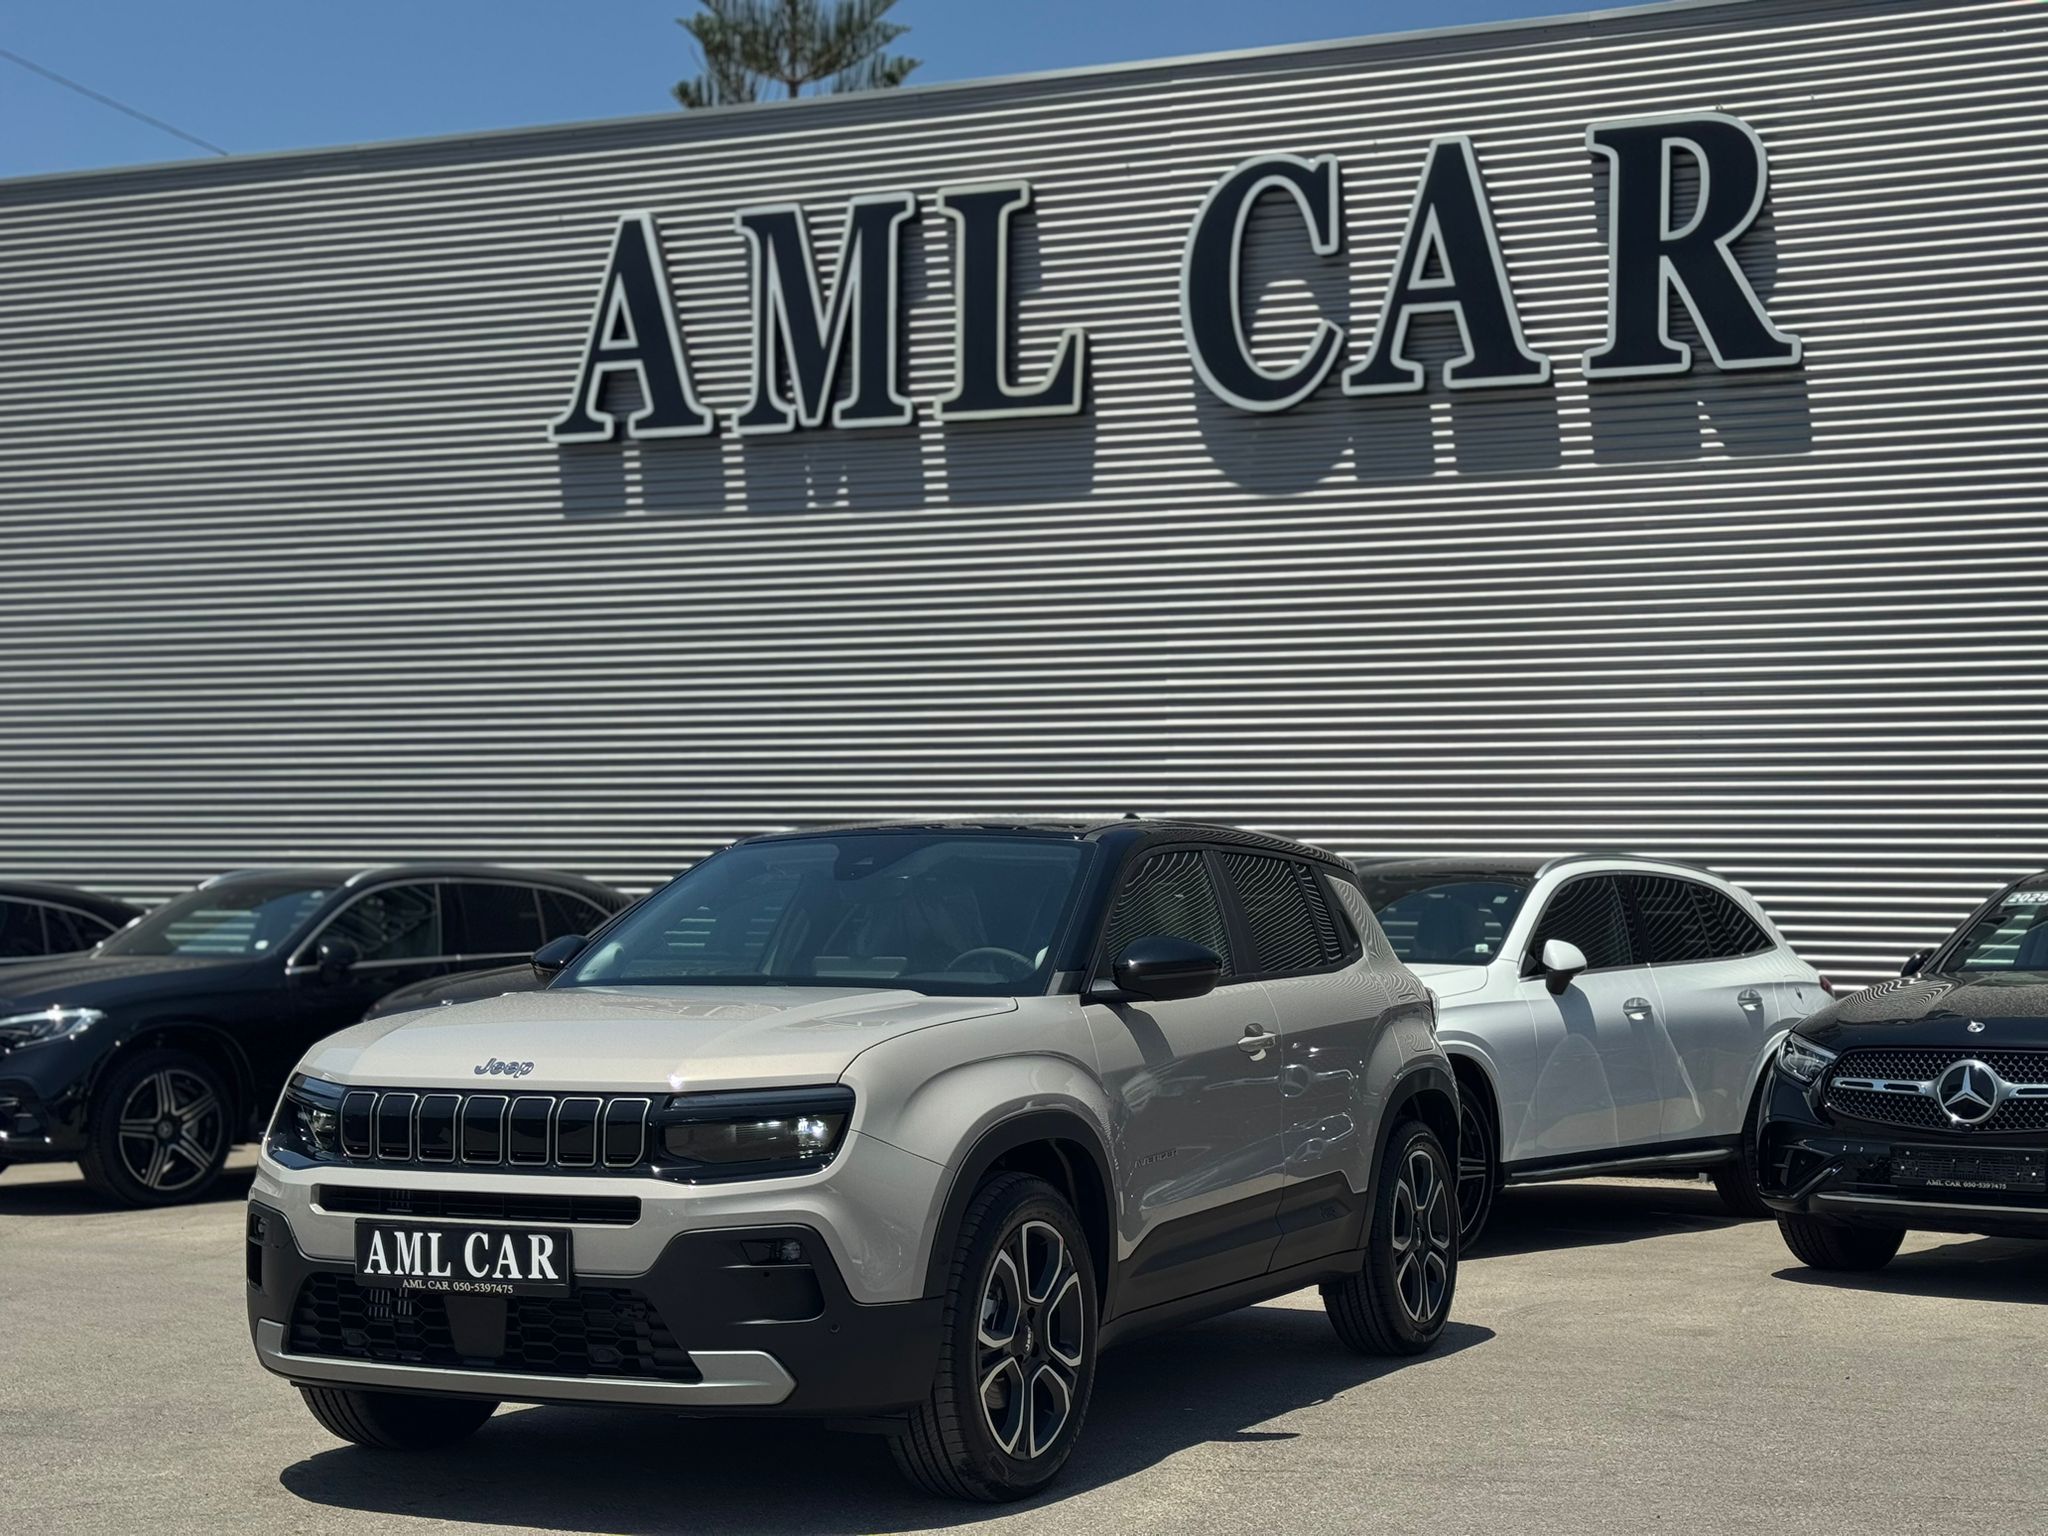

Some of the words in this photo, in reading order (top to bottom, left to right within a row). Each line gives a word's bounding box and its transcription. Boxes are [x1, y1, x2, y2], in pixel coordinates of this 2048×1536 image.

[546, 181, 1089, 443] AML
[1181, 112, 1803, 412] CAR
[474, 1057, 535, 1078] Jeep
[1945, 1180, 1961, 1188] CAR
[1963, 1181, 2007, 1190] 050-5397475
[363, 1230, 451, 1277] AML
[464, 1231, 559, 1280] CAR
[402, 1279, 425, 1289] AML
[427, 1280, 450, 1291] CAR
[453, 1281, 514, 1294] 050-5397475
